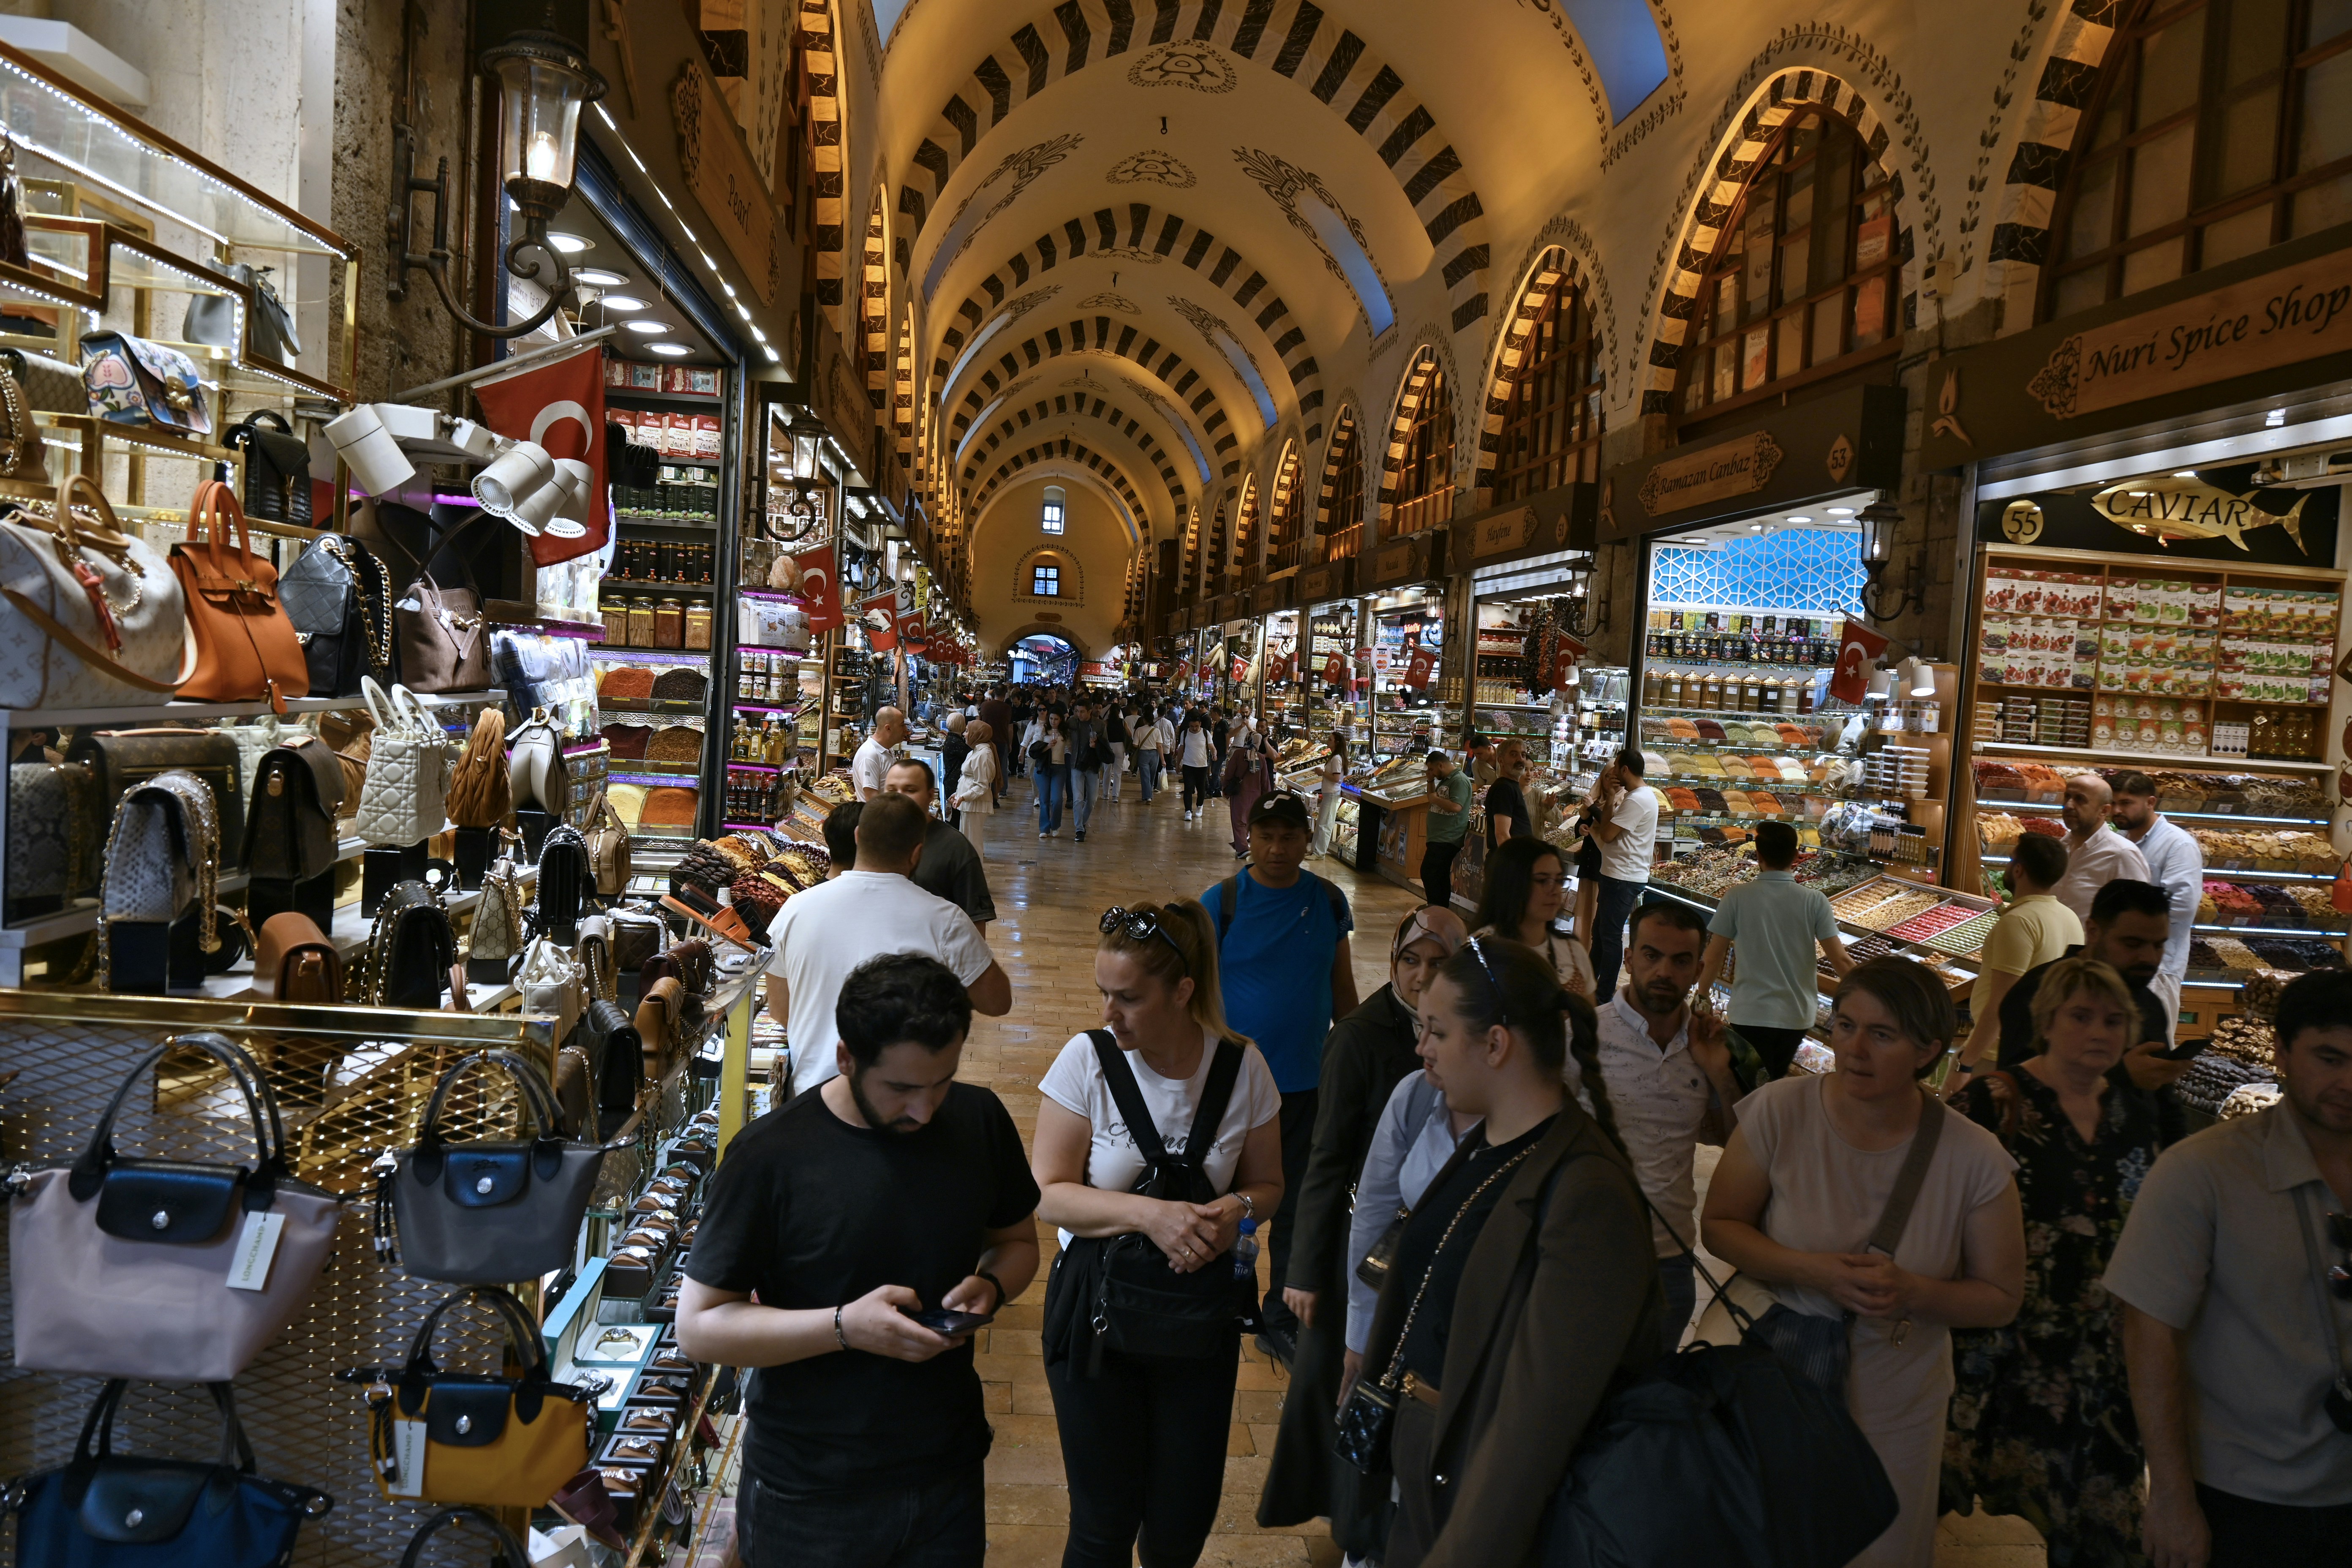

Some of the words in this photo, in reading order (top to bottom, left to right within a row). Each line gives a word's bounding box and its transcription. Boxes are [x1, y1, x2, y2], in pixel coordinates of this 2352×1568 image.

[728, 173, 751, 236] Pearl
[2085, 331, 2158, 382] Nuri
[2165, 314, 2249, 371] Spice
[2259, 285, 2352, 335] Shop
[1660, 470, 1707, 495] Ramazan
[1710, 453, 1750, 481] Canbaz
[1832, 449, 1846, 470] 53
[2008, 510, 2039, 536] 55
[2107, 489, 2250, 527] CAVIAR
[1486, 523, 1511, 544] Hayfene
[1558, 524, 1564, 537] 51
[242, 1226, 265, 1281] LONGCHAMP
[402, 1434, 412, 1489] LONGCHAMP
